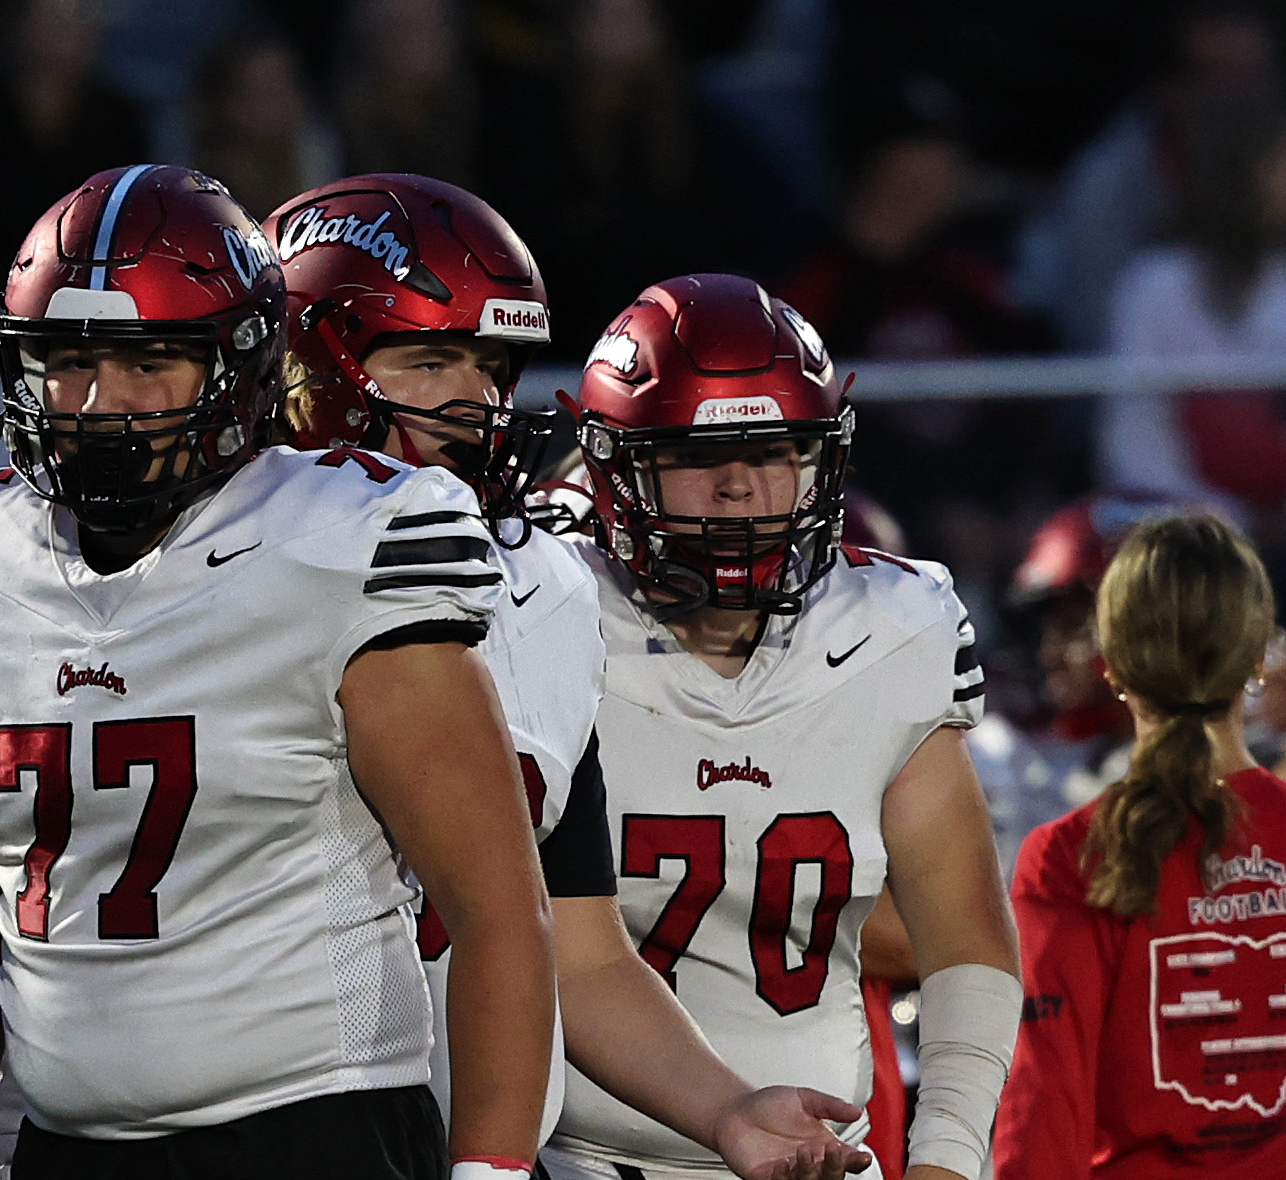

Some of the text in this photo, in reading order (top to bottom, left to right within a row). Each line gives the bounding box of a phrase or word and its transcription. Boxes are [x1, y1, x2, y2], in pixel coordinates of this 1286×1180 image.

[279, 206, 411, 282] Chardon
[492, 308, 548, 330] Riddell
[715, 567, 749, 578] Riddel
[56, 661, 127, 696] Chardon
[696, 755, 773, 792] Chardon
[619, 810, 855, 1018] 70
